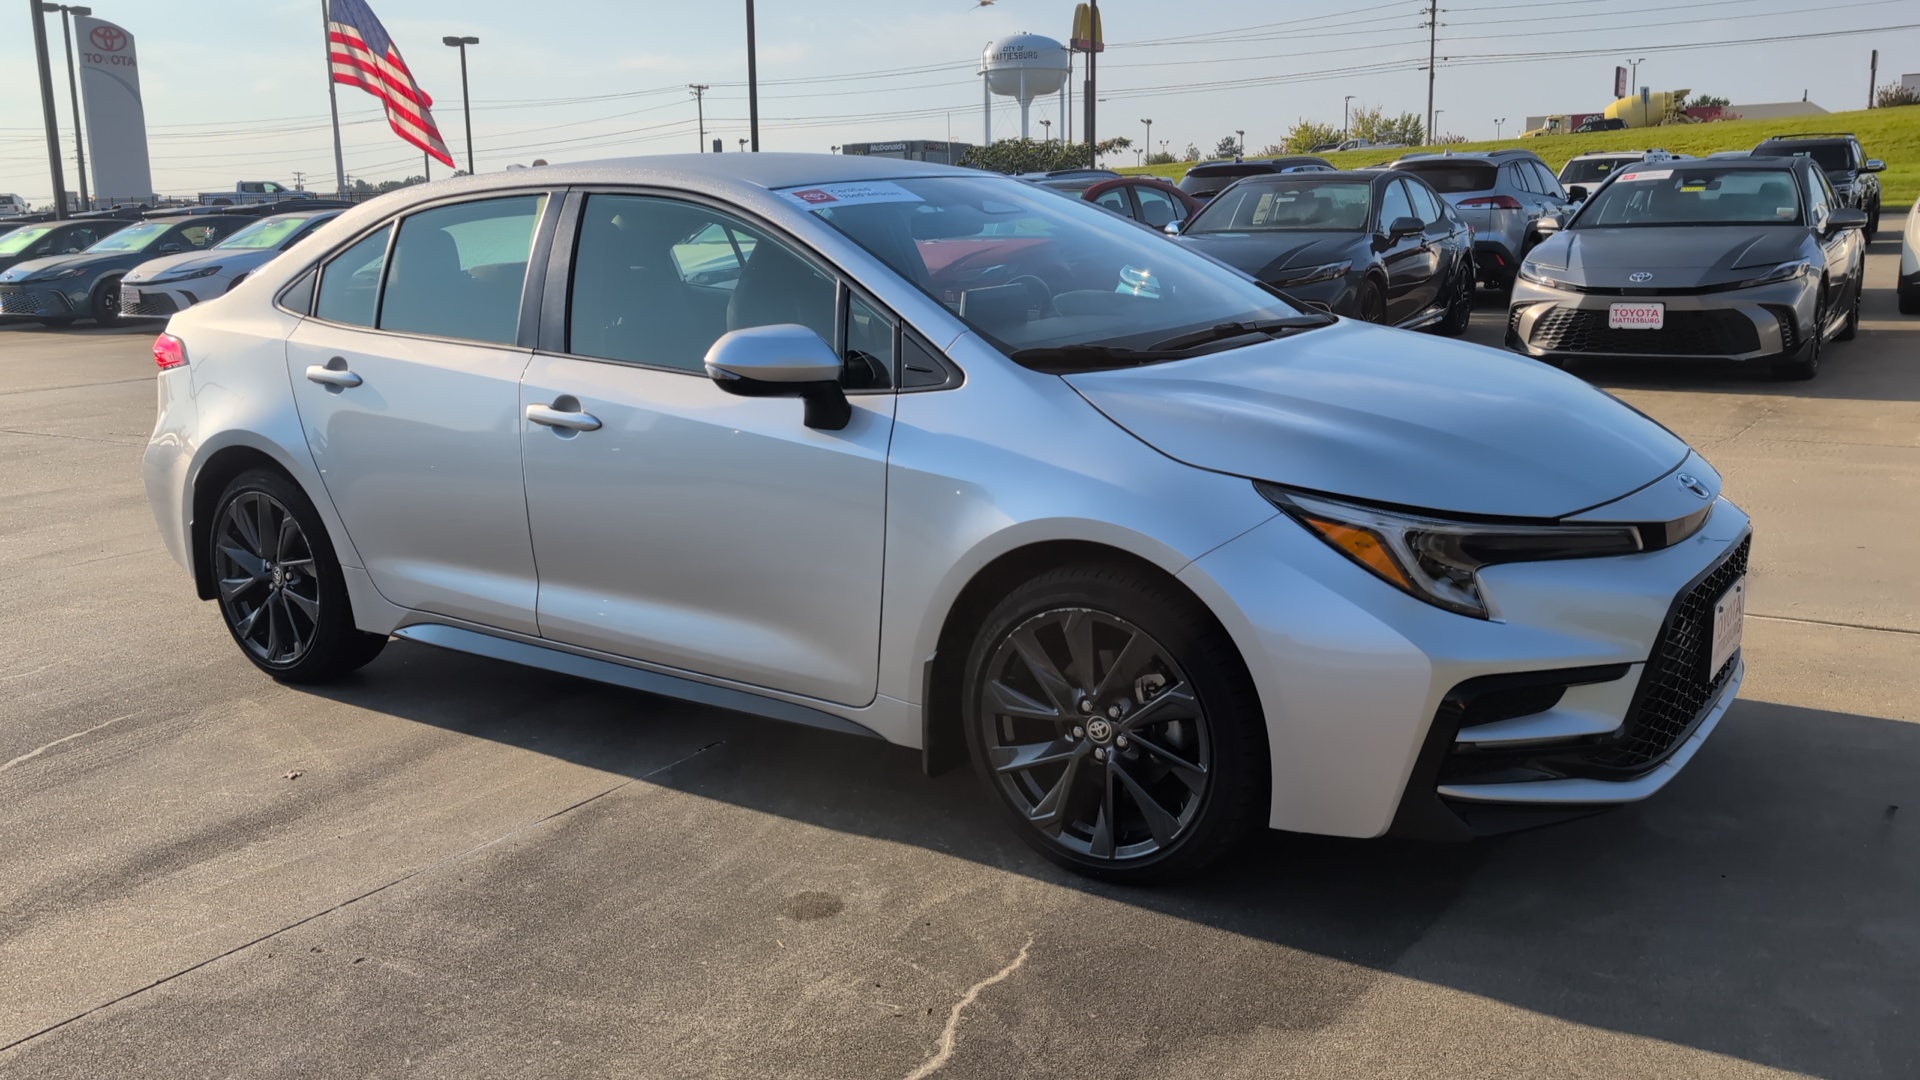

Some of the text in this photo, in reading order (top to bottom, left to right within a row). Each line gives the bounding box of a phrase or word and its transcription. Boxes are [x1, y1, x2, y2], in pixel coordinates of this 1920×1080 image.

[992, 52, 1038, 61] HATTIESBURG
[870, 143, 907, 151] McDonald's
[1613, 309, 1659, 317] TOYOTA
